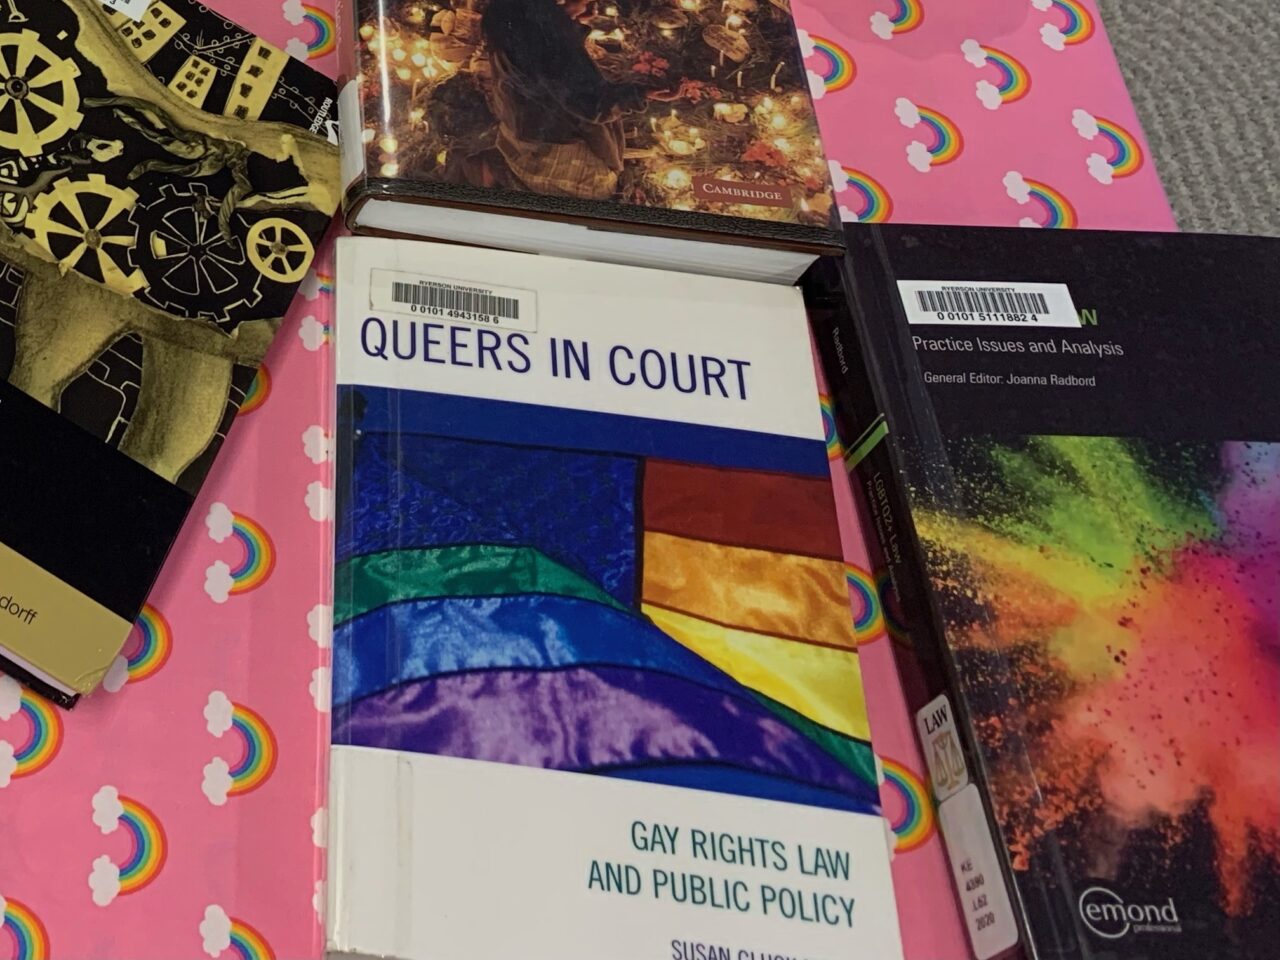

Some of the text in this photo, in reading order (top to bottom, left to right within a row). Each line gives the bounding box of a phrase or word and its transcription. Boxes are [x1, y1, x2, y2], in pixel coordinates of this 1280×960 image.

[309, 97, 333, 134] ROUTLEDGE
[702, 183, 783, 201] CAMBRIDGE
[420, 305, 490, 323] 0101 4943158
[948, 312, 1029, 322] 0101 5111882
[360, 317, 751, 400] QUEERS IN COURT
[832, 326, 849, 375] Radbord
[912, 336, 1124, 358] Practice Issues and Analysis
[924, 371, 1096, 387] General Editor: Joanna Radbord
[923, 704, 949, 735] LAW
[631, 820, 850, 881] GAY RIGHTS LAW
[588, 860, 855, 928] AND PUBLIC POLICY
[1085, 897, 1179, 923] emond
[671, 940, 731, 960] SUSAN
